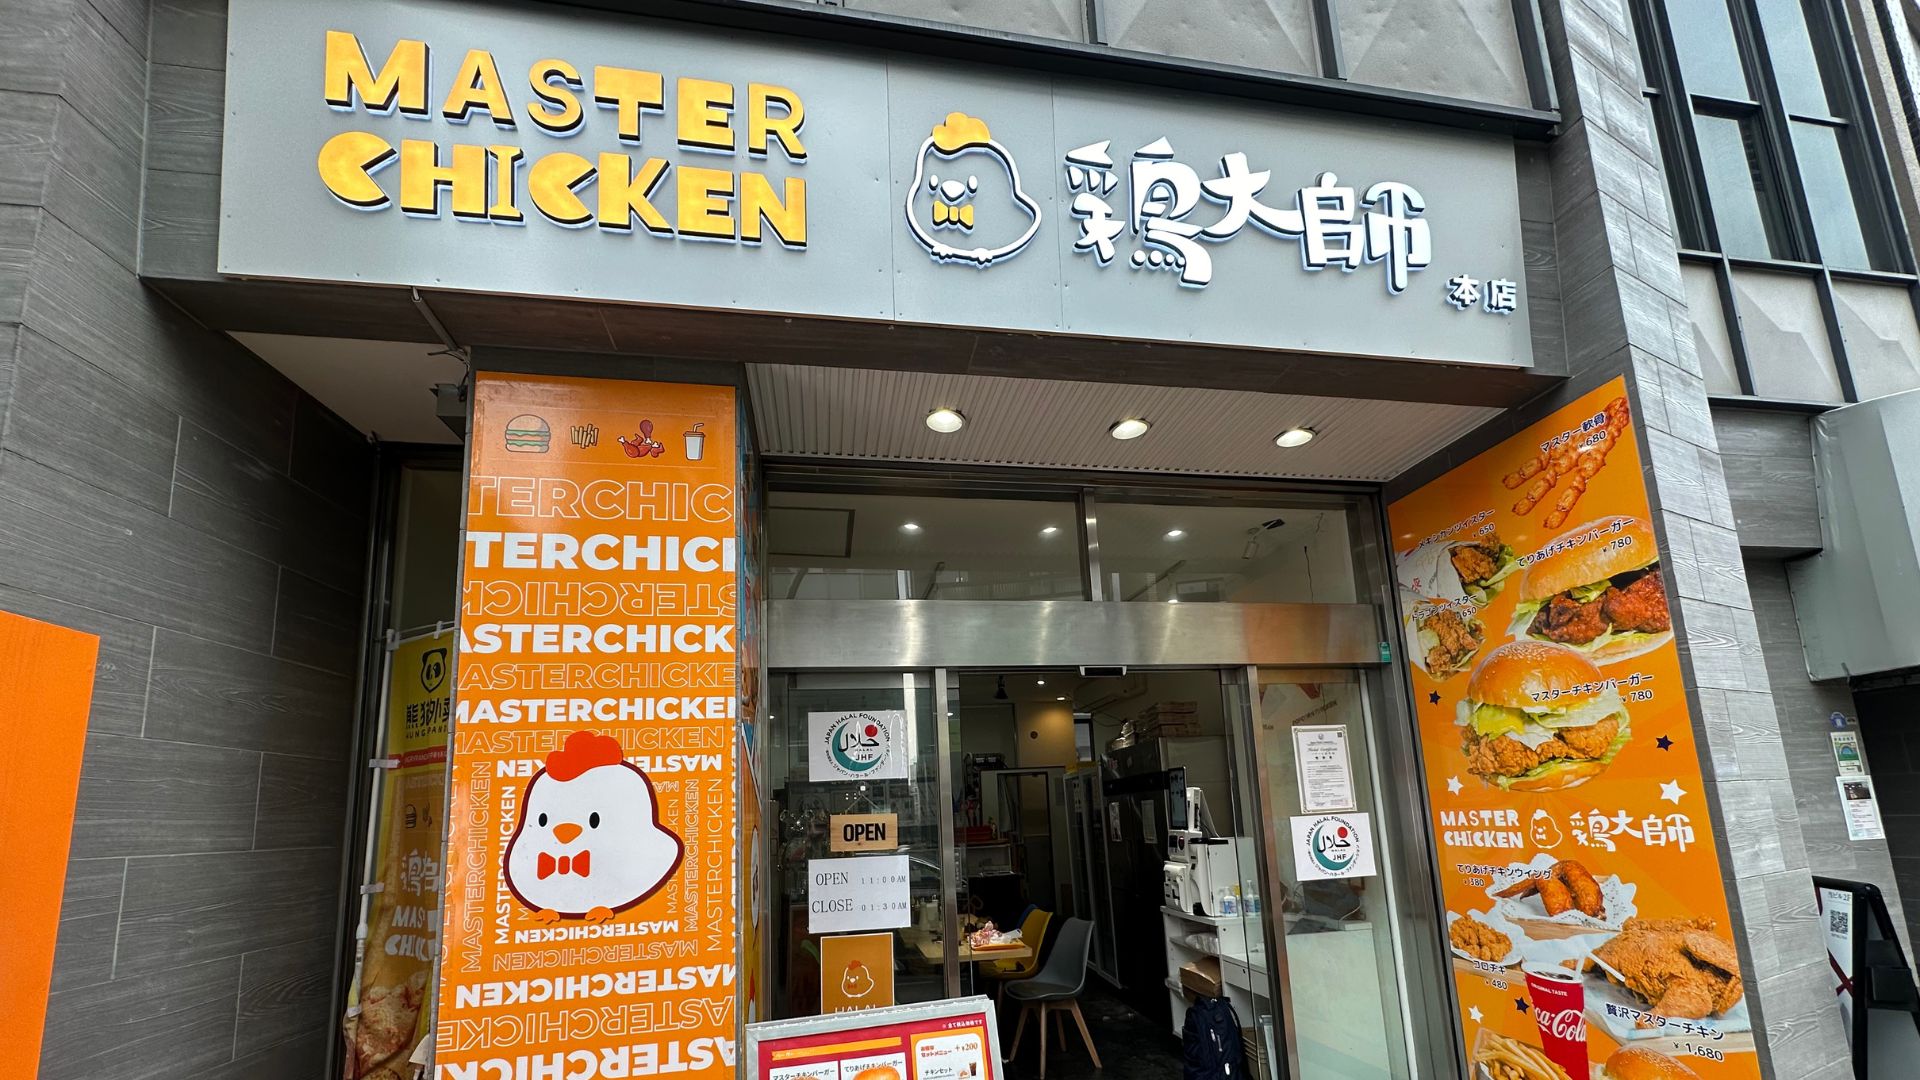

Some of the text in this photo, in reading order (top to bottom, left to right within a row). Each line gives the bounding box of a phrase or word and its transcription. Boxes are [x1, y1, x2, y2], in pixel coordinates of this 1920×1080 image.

[325, 30, 807, 163] MASTER
[318, 130, 808, 250] CHICKEN
[1065, 136, 1431, 294] 鶏大師
[1446, 274, 1518, 313] 本店
[1541, 412, 1605, 451] マスター軟骨
[1516, 518, 1634, 567] てりあげチキンバーガー
[1531, 673, 1653, 702] マスターチキンバーガー
[824, 712, 891, 745] JAPAN HALAL FOUNDATION
[843, 823, 886, 842] OPEN
[1440, 809, 1520, 827] MASTER
[1569, 808, 1696, 853] 鶏大師
[684, 779, 700, 933] MASTERCHICKEN
[1444, 830, 1524, 848] CHICKEN
[461, 761, 492, 973] MASTERCHICKEN
[706, 778, 723, 951] MASTERCHICKEN
[815, 872, 849, 886] OPEN
[1456, 864, 1552, 879] てりあげチキンウイング
[812, 898, 853, 913] CLOSE
[515, 919, 679, 944] MASTERCHICKEN
[493, 939, 699, 972] MASTERCHICKEN
[1473, 960, 1506, 975] コロチキ
[1605, 1003, 1725, 1041] 贅沢マスターチキン
